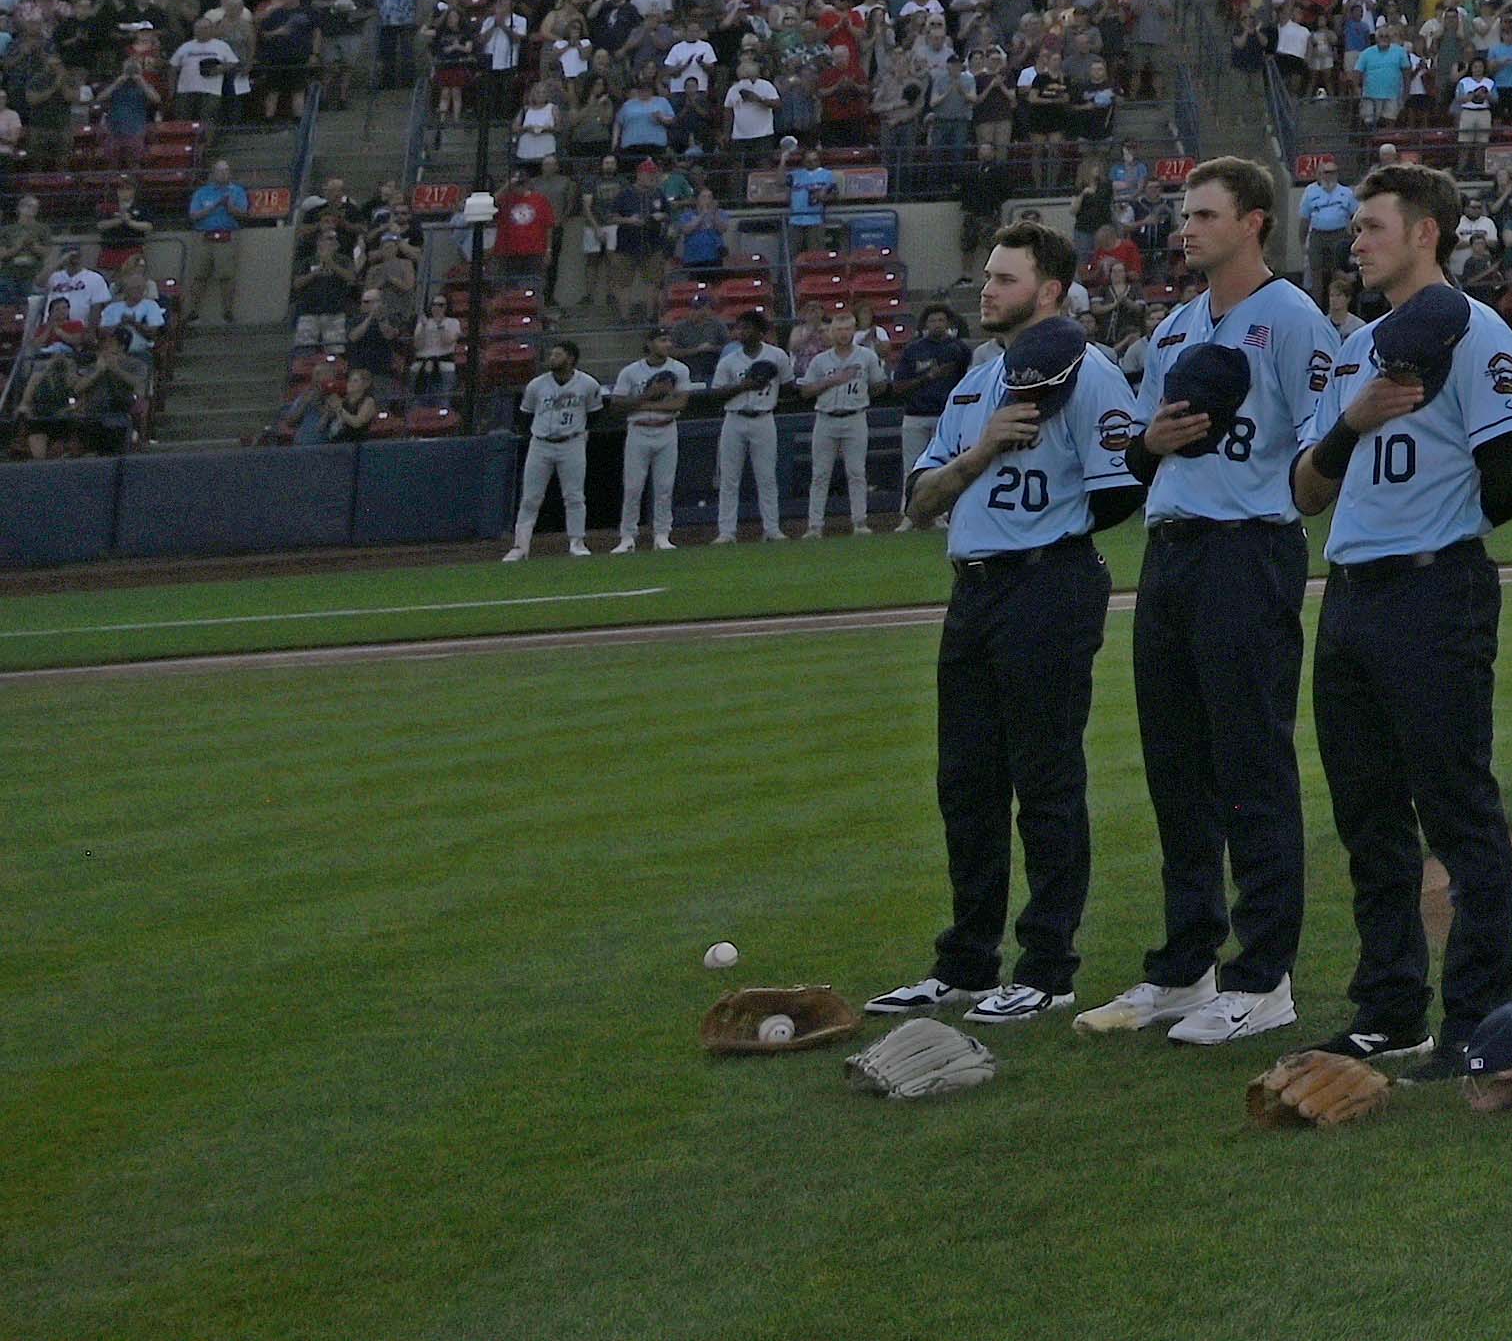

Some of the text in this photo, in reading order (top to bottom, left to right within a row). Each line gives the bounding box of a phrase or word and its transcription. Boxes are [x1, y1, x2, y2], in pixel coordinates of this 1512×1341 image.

[1165, 161, 1185, 175] 217
[561, 412, 574, 426] 31
[1373, 433, 1416, 485] 10
[988, 466, 1049, 513] 20
